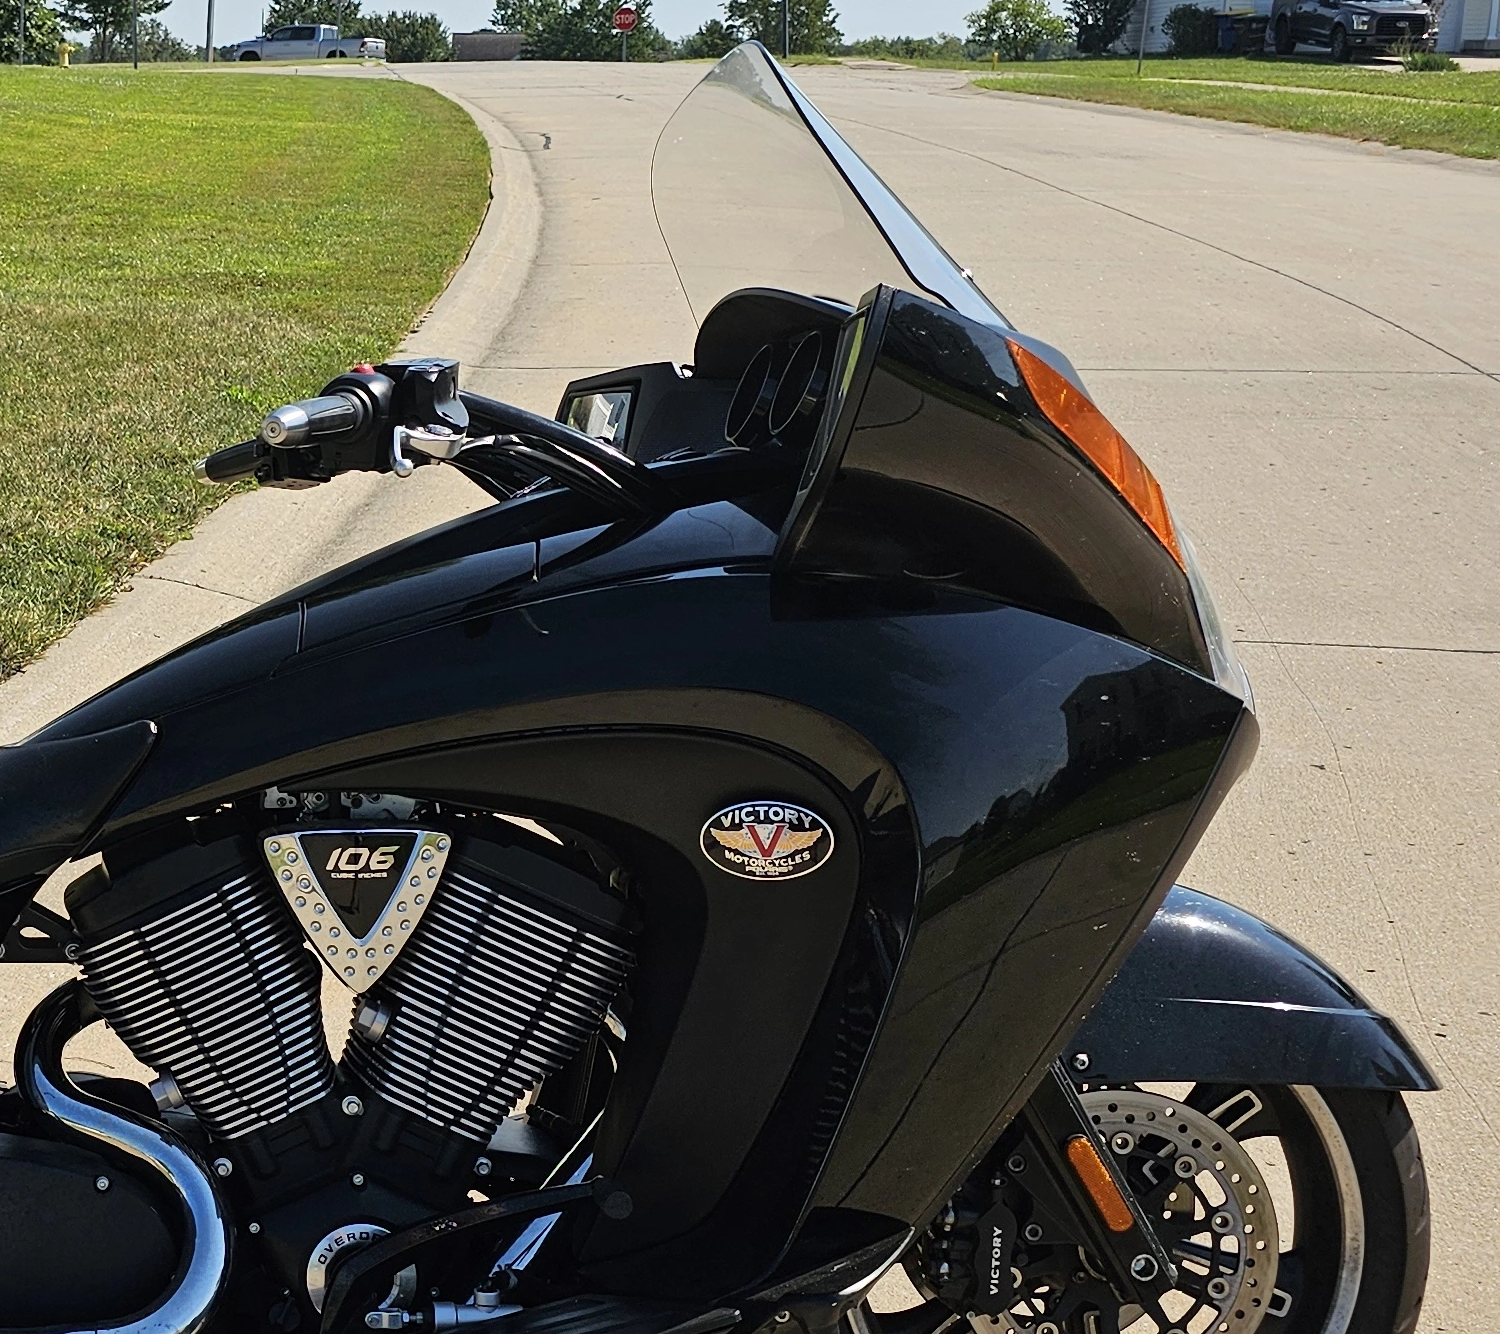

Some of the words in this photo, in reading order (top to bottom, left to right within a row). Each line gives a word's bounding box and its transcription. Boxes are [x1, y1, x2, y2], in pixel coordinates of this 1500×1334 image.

[615, 14, 635, 24] STOP
[720, 806, 813, 829] VICTORY
[325, 846, 400, 871] 106
[724, 849, 811, 867] MOTORCYCLES
[989, 1226, 1003, 1295] VICTORY
